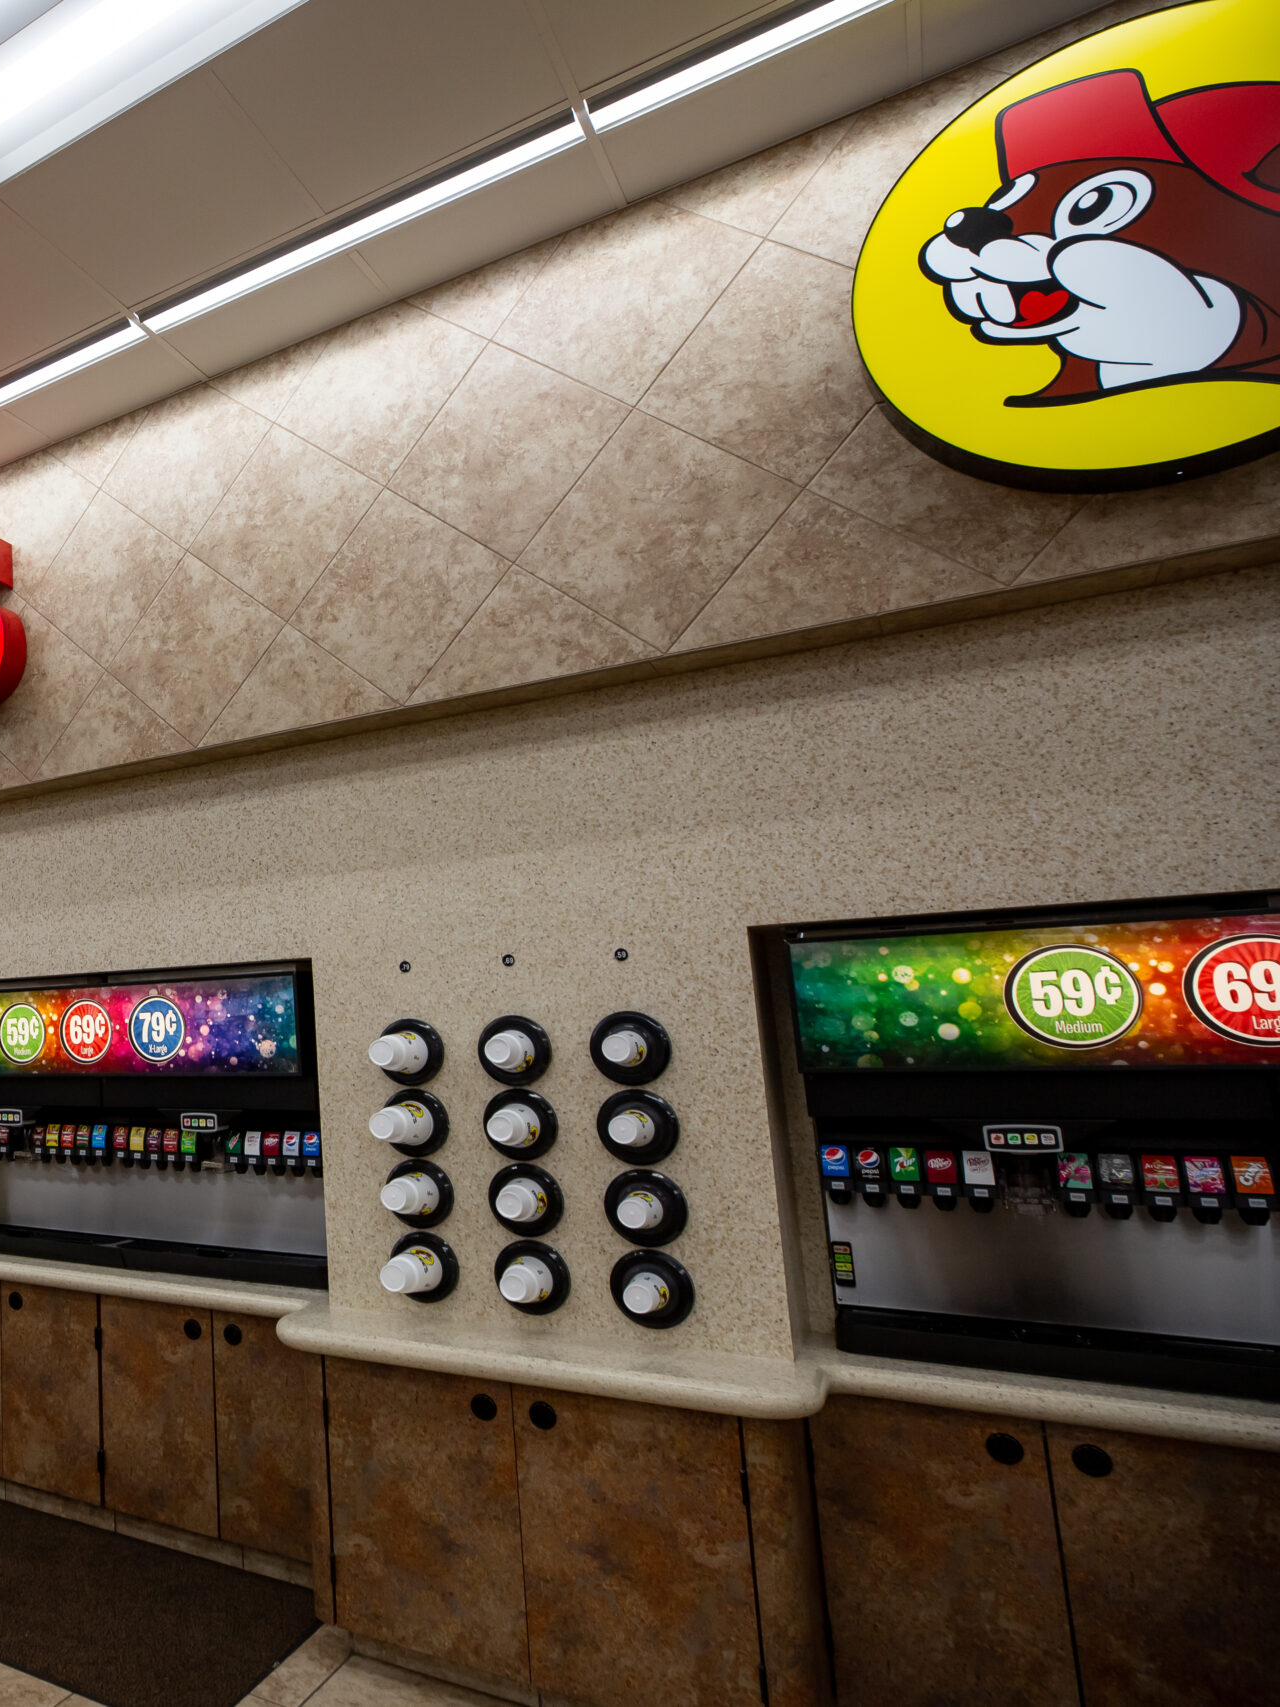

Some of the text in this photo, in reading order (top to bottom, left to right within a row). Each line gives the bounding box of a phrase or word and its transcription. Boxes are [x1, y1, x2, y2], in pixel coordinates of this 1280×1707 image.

[1028, 965, 1122, 1018] 59¢
[1213, 960, 1280, 1013] 69
[6, 1016, 39, 1046] 59¢
[69, 1013, 106, 1044] 69¢
[138, 1009, 177, 1043] 79¢
[1055, 1020, 1103, 1034] Medium
[1252, 1015, 1280, 1033] Larg
[80, 1045, 94, 1056] Large
